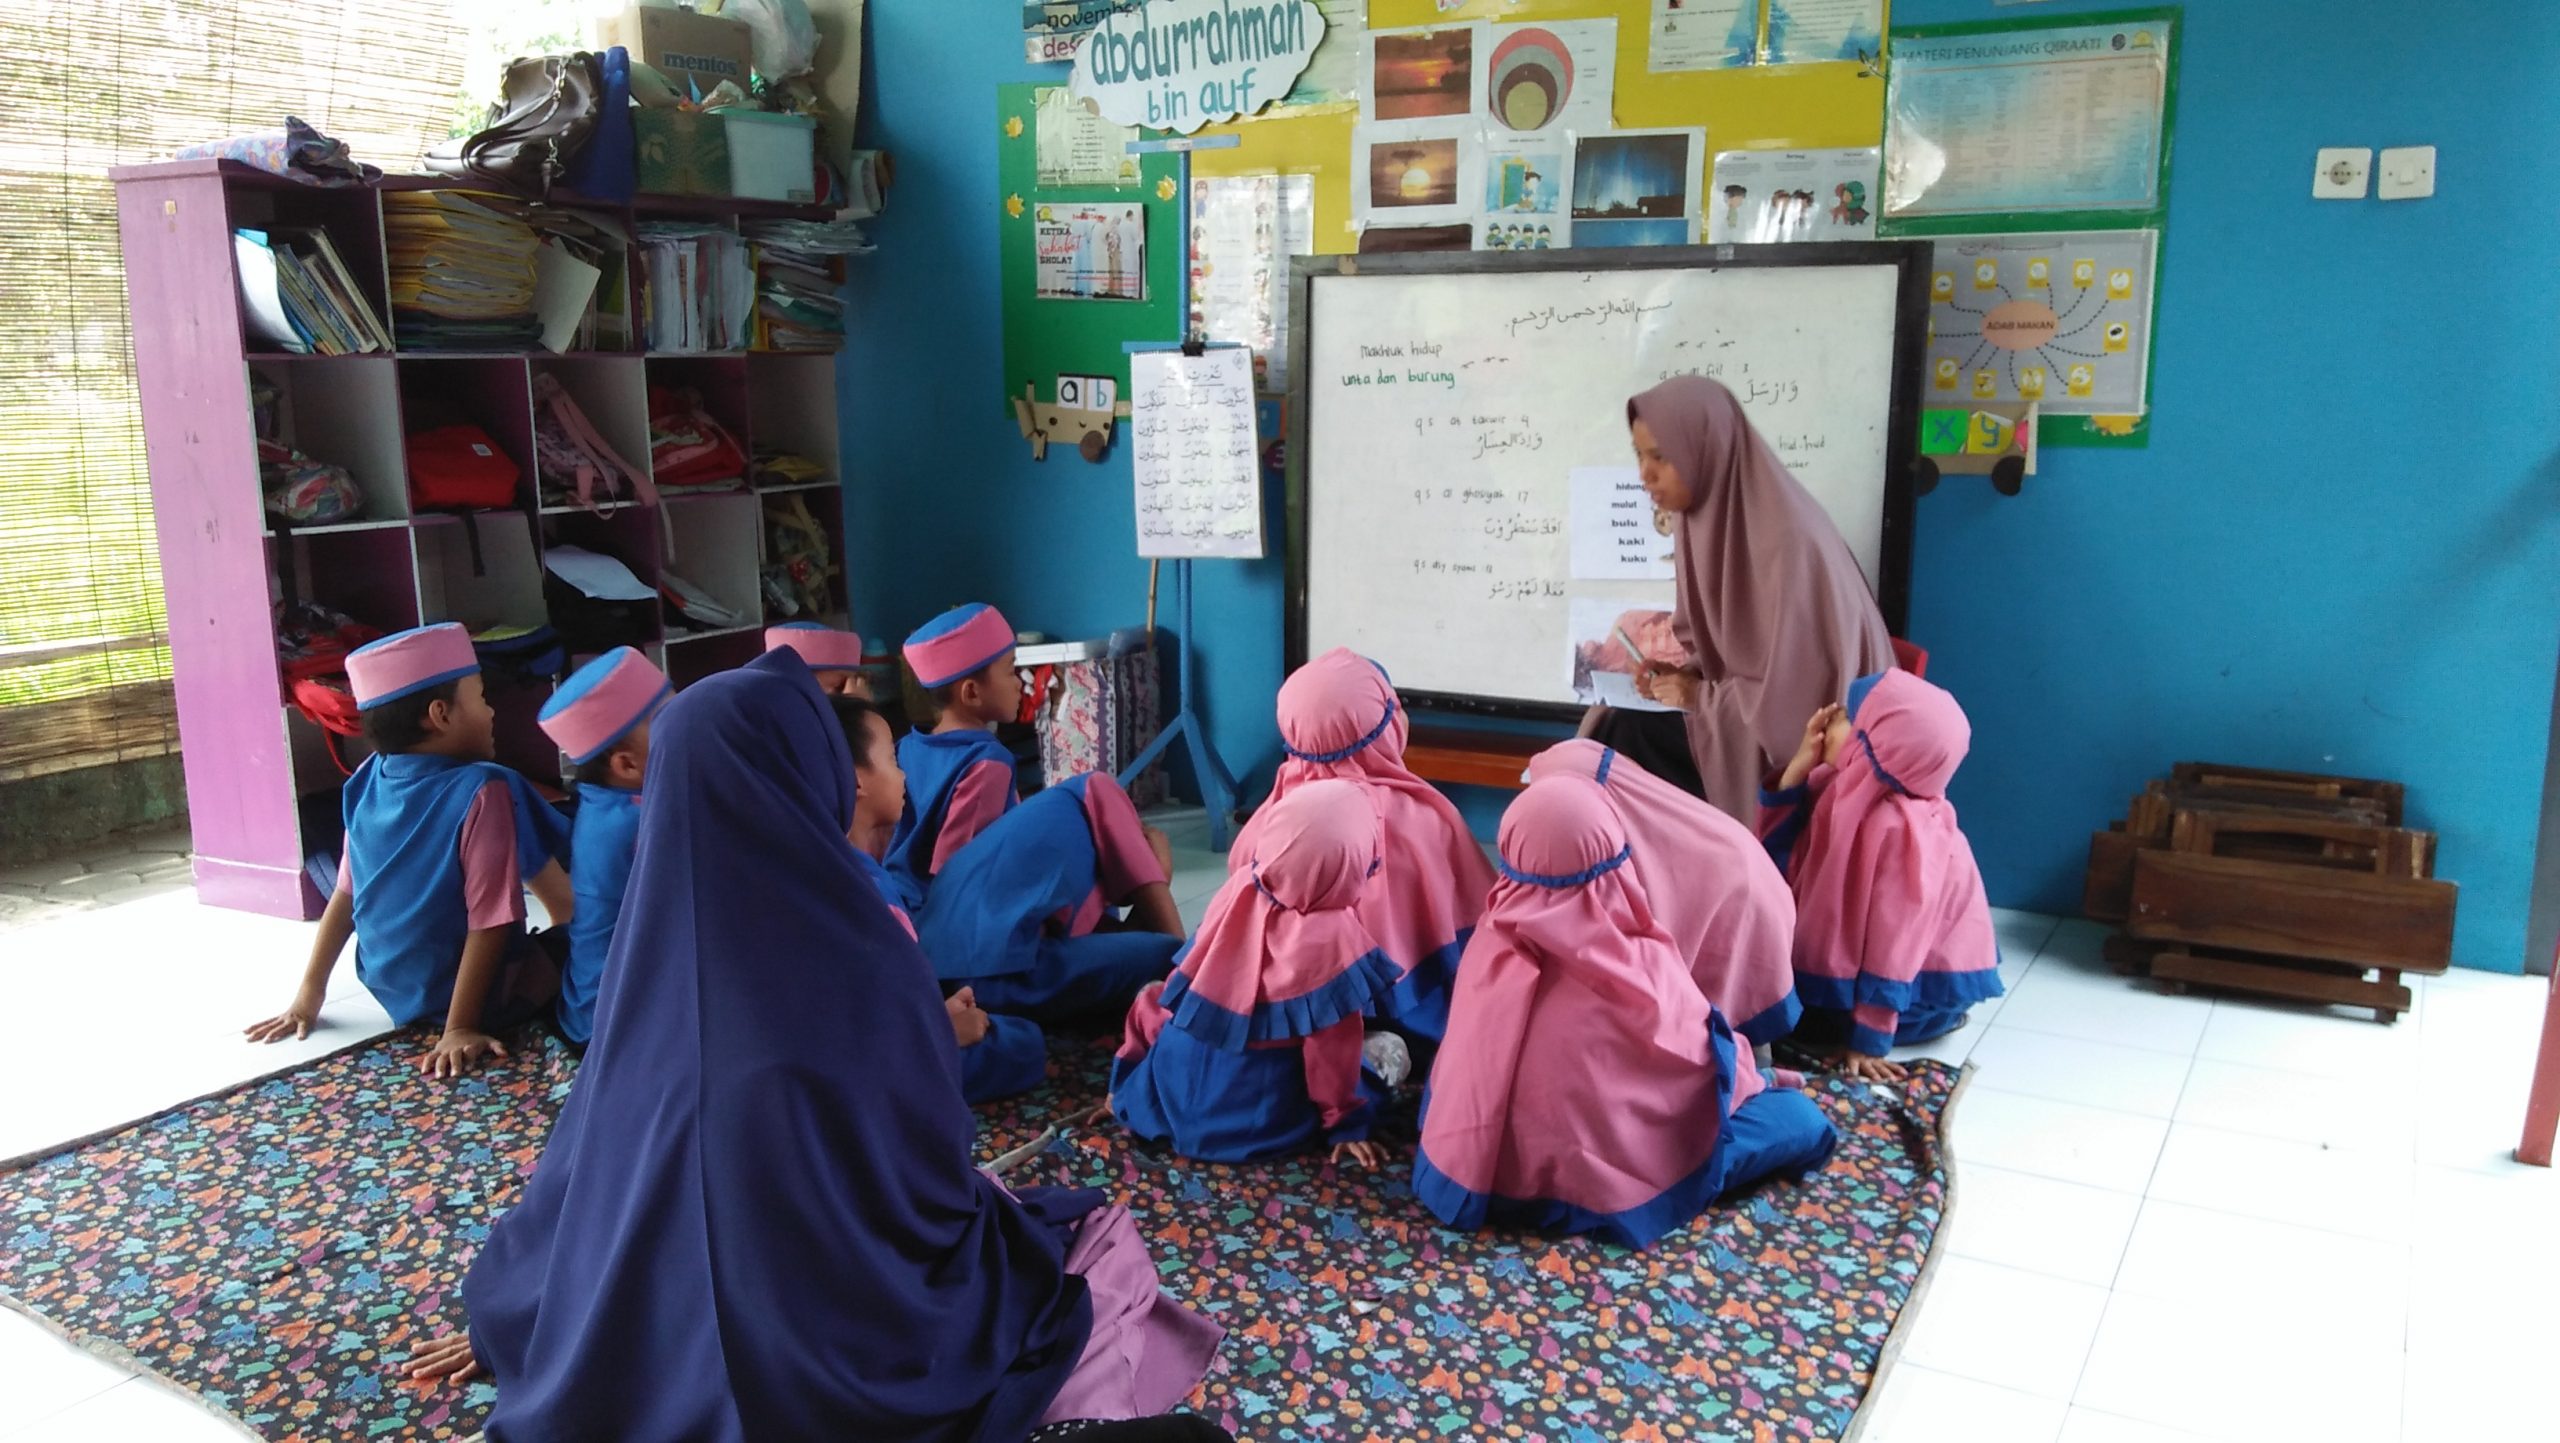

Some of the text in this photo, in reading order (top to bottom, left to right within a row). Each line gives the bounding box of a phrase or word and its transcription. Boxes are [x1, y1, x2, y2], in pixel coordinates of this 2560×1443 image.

[1091, 0, 1305, 85] abdurrahman
[1952, 42, 2040, 60] PENUNJANG
[663, 51, 738, 76] mentos
[1148, 67, 1257, 123] bin auf
[2016, 320, 2055, 330] MAKAN
[1411, 340, 1443, 358] hidup
[1342, 367, 1455, 389] unta dan burung
[1061, 380, 1079, 404] a
[1096, 379, 1107, 407] b
[1611, 501, 1637, 509] mulut
[1611, 519, 1638, 527] bulu
[1618, 537, 1645, 546] kaki
[1621, 554, 1648, 563] kuku
